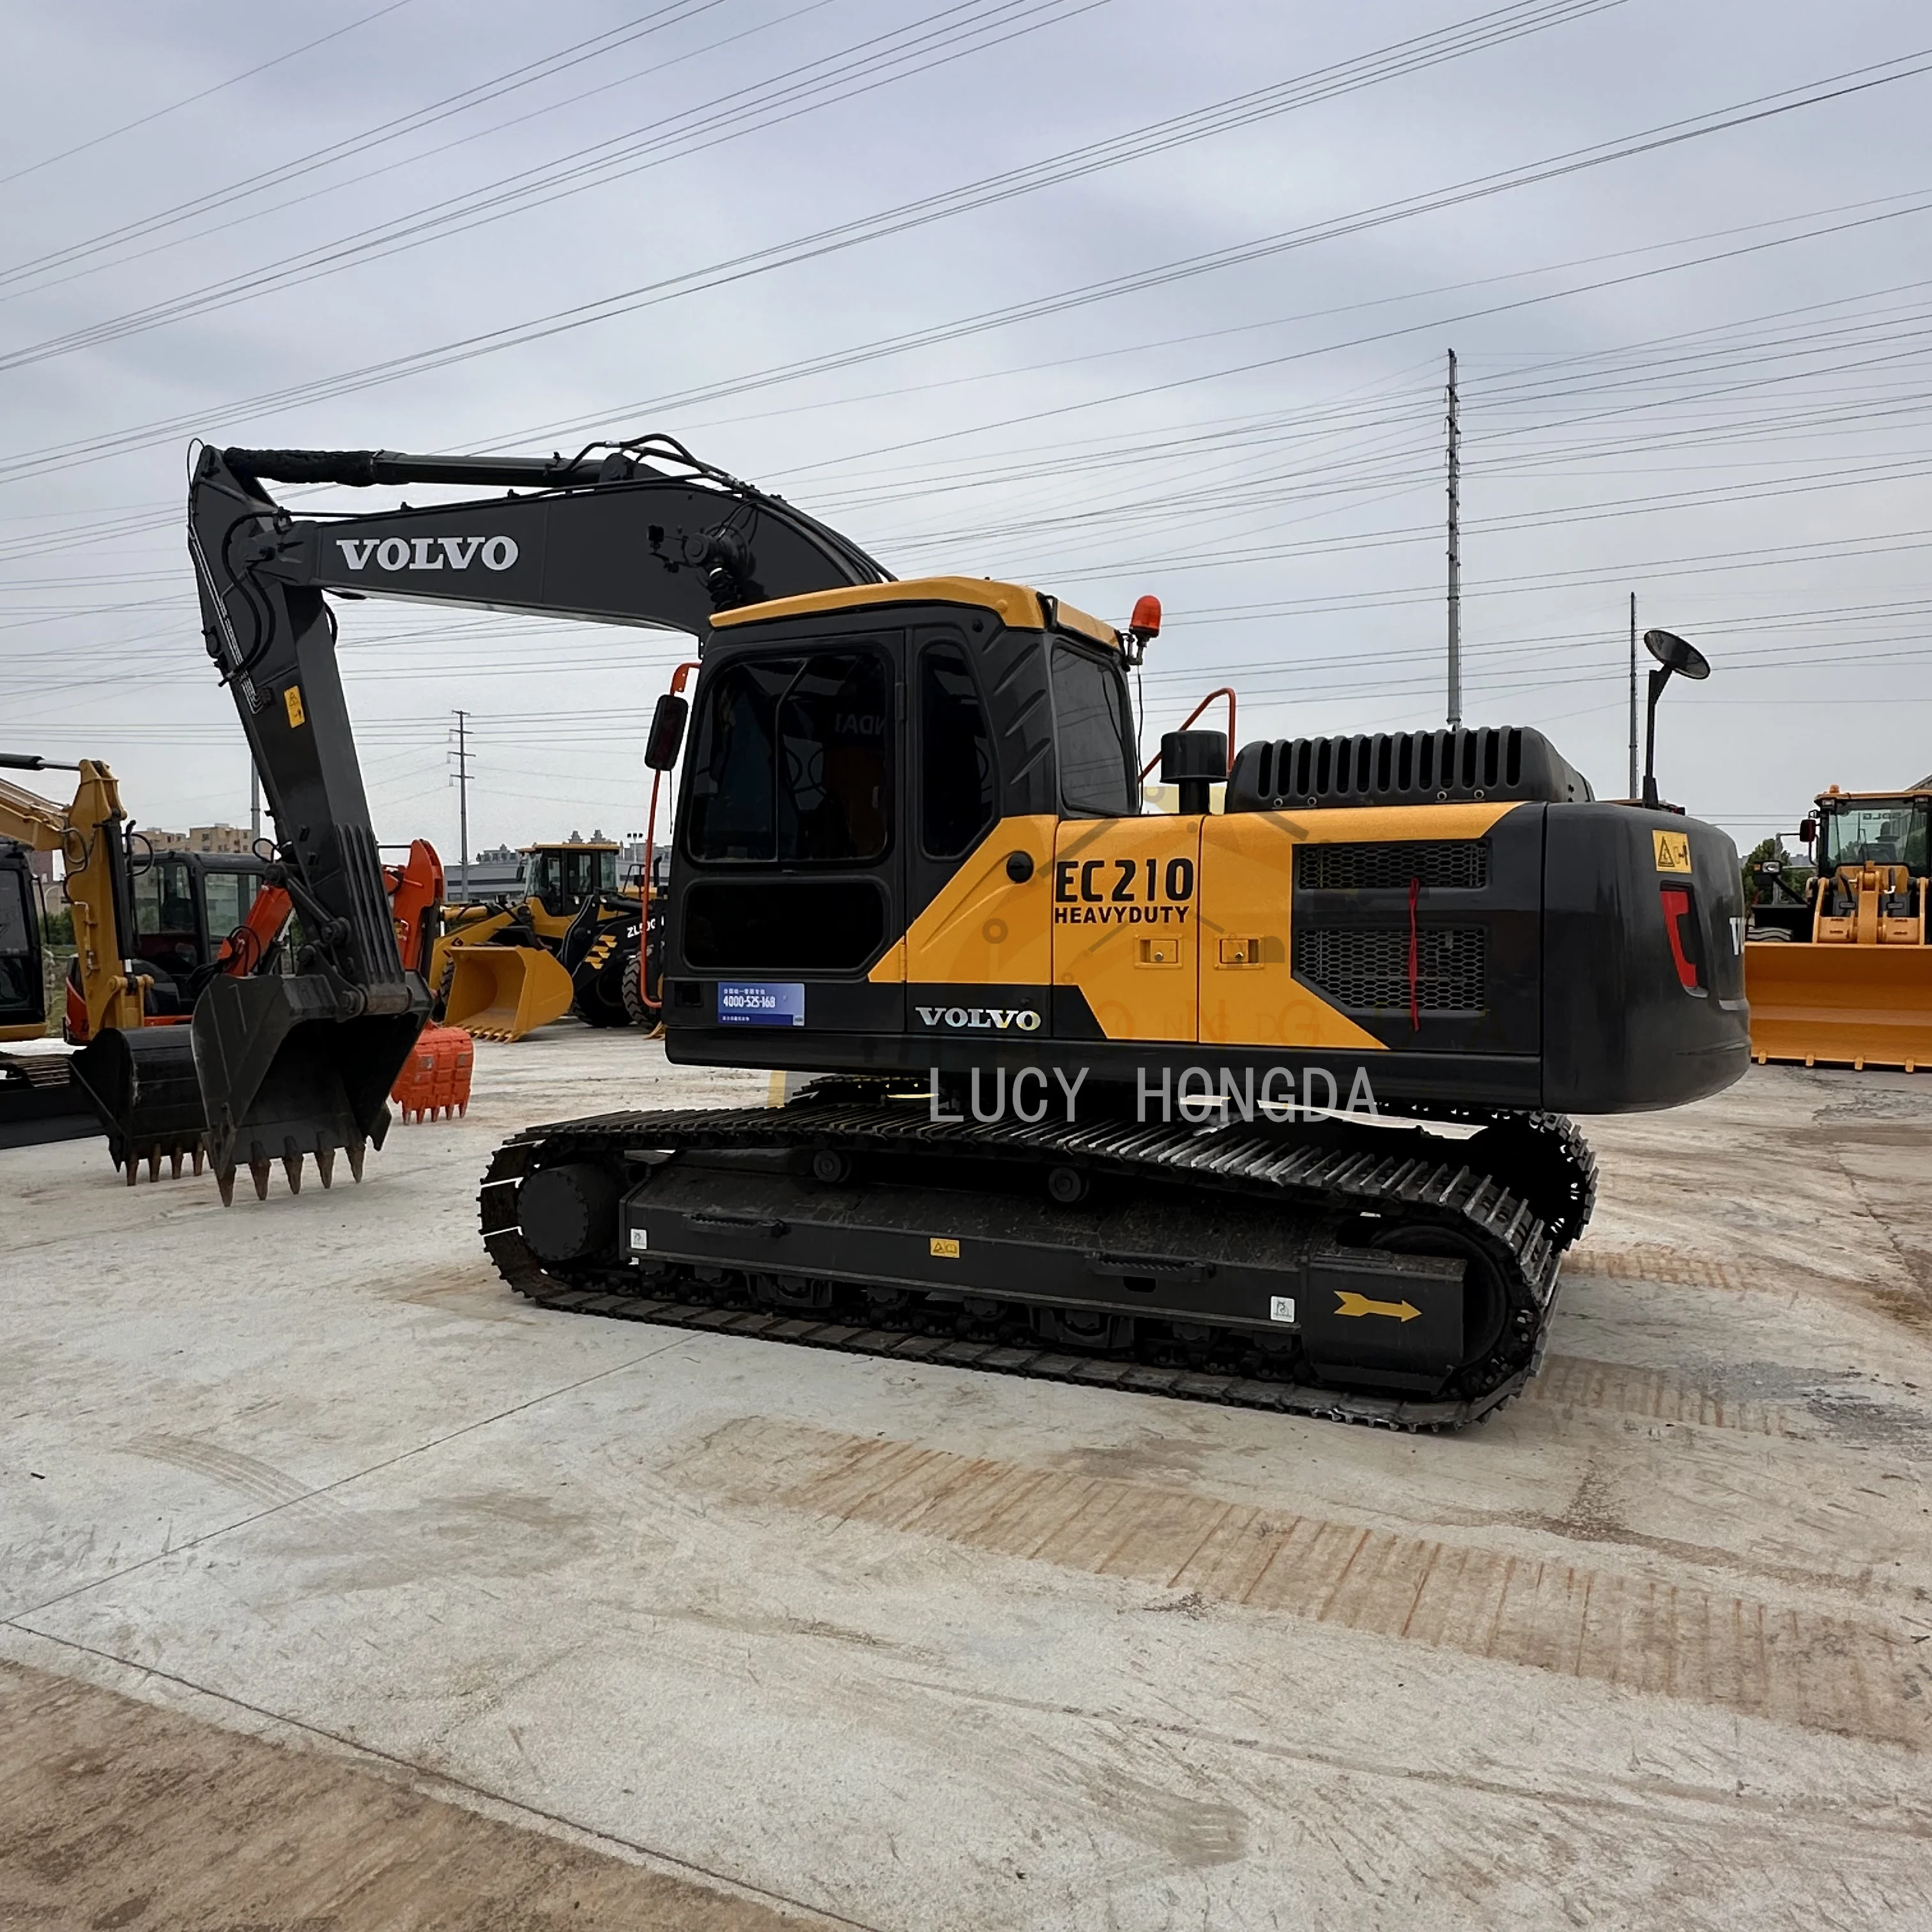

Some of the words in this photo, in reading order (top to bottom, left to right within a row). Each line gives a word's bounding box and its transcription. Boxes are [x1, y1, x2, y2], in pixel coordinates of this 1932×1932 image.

[337, 535, 519, 571] VOLVO
[1055, 857, 1194, 903] EC210
[1055, 906, 1190, 924] HEAVYDUTY
[915, 1007, 1041, 1031] VOLVO
